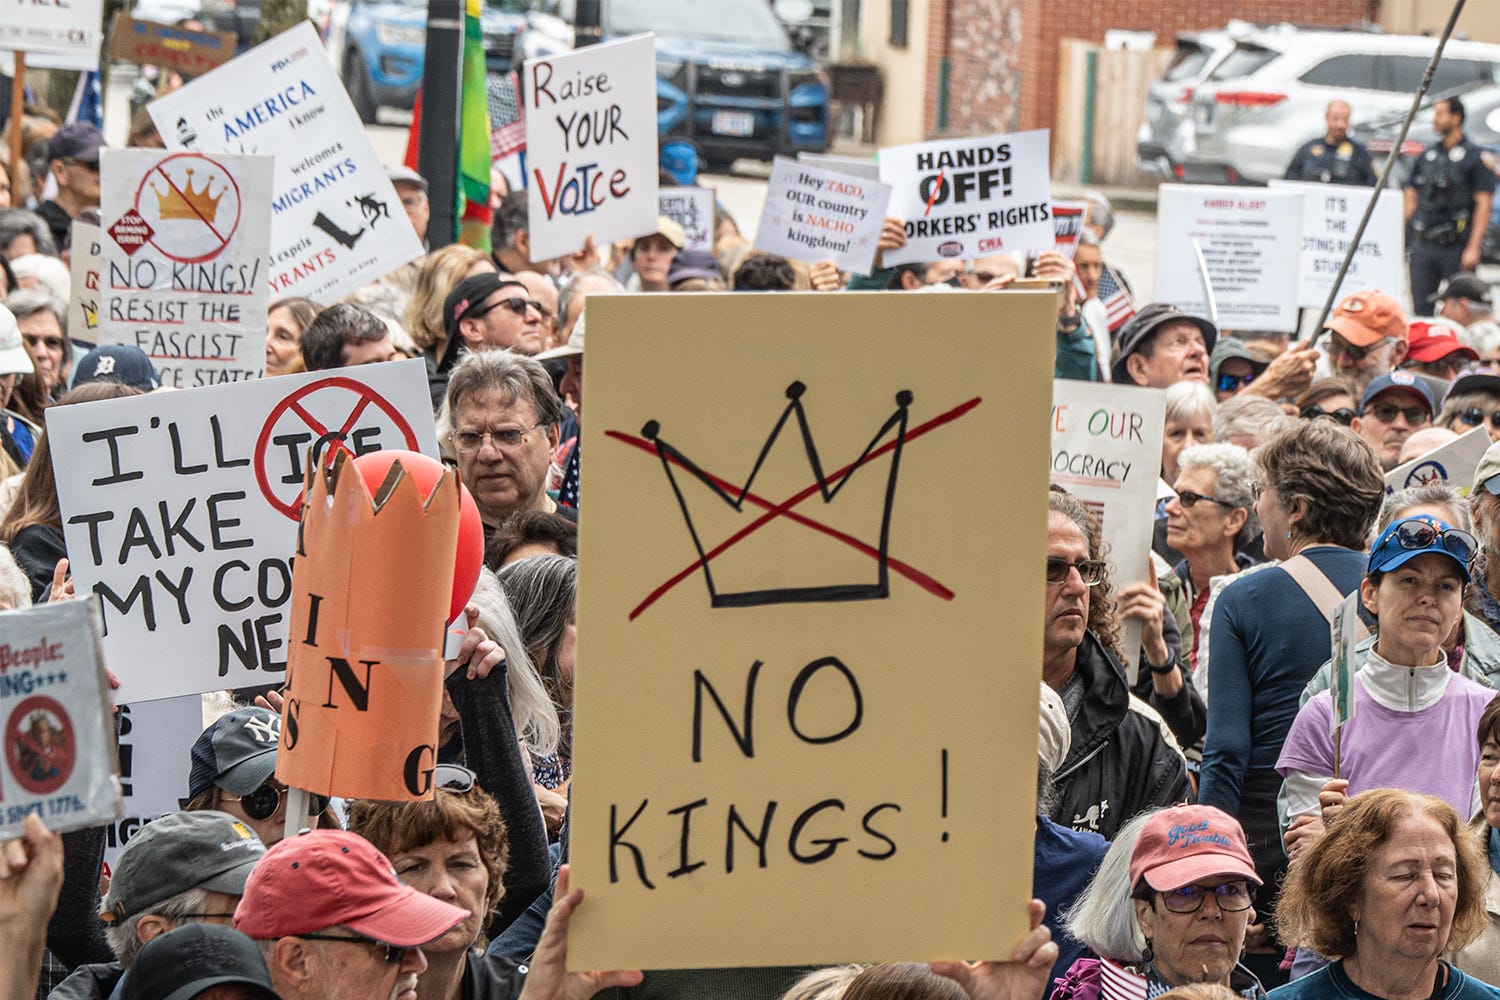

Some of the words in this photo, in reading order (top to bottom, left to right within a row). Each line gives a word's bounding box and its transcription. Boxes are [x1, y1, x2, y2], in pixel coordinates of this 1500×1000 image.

[533, 62, 612, 108] Raise
[205, 105, 226, 122] the
[223, 80, 316, 142] AMERICA
[295, 104, 326, 126] know
[556, 105, 629, 152] YOUR
[291, 141, 344, 176] welcomes
[917, 145, 1011, 170] HANDS
[799, 173, 825, 191] Hey
[826, 179, 865, 200] TACO,
[919, 167, 1013, 207] OFF!
[121, 215, 143, 225] STOP
[787, 190, 815, 207] OUR
[818, 199, 869, 220] country
[793, 212, 804, 224] is
[805, 214, 855, 234] NACHO
[905, 214, 981, 239] ORKERS'
[988, 203, 1048, 229] RIGHTS
[1326, 219, 1346, 233] THE
[277, 236, 313, 266] expels
[787, 228, 850, 253] kingdom!
[110, 260, 158, 289] NO
[172, 258, 260, 294] KINGS!
[268, 247, 337, 294] YRANTS
[110, 297, 188, 322] RESIST
[200, 301, 241, 321] THE
[136, 330, 243, 360] FASCIST
[1088, 408, 1143, 444] OUR
[82, 414, 250, 487] I'LL
[1054, 450, 1131, 482] OCRACY
[68, 491, 254, 566] TAKE
[93, 566, 194, 637] MY
[213, 557, 295, 612] CO
[692, 656, 863, 763] NO
[1168, 820, 1208, 846] Good
[1181, 832, 1231, 850] Trouble
